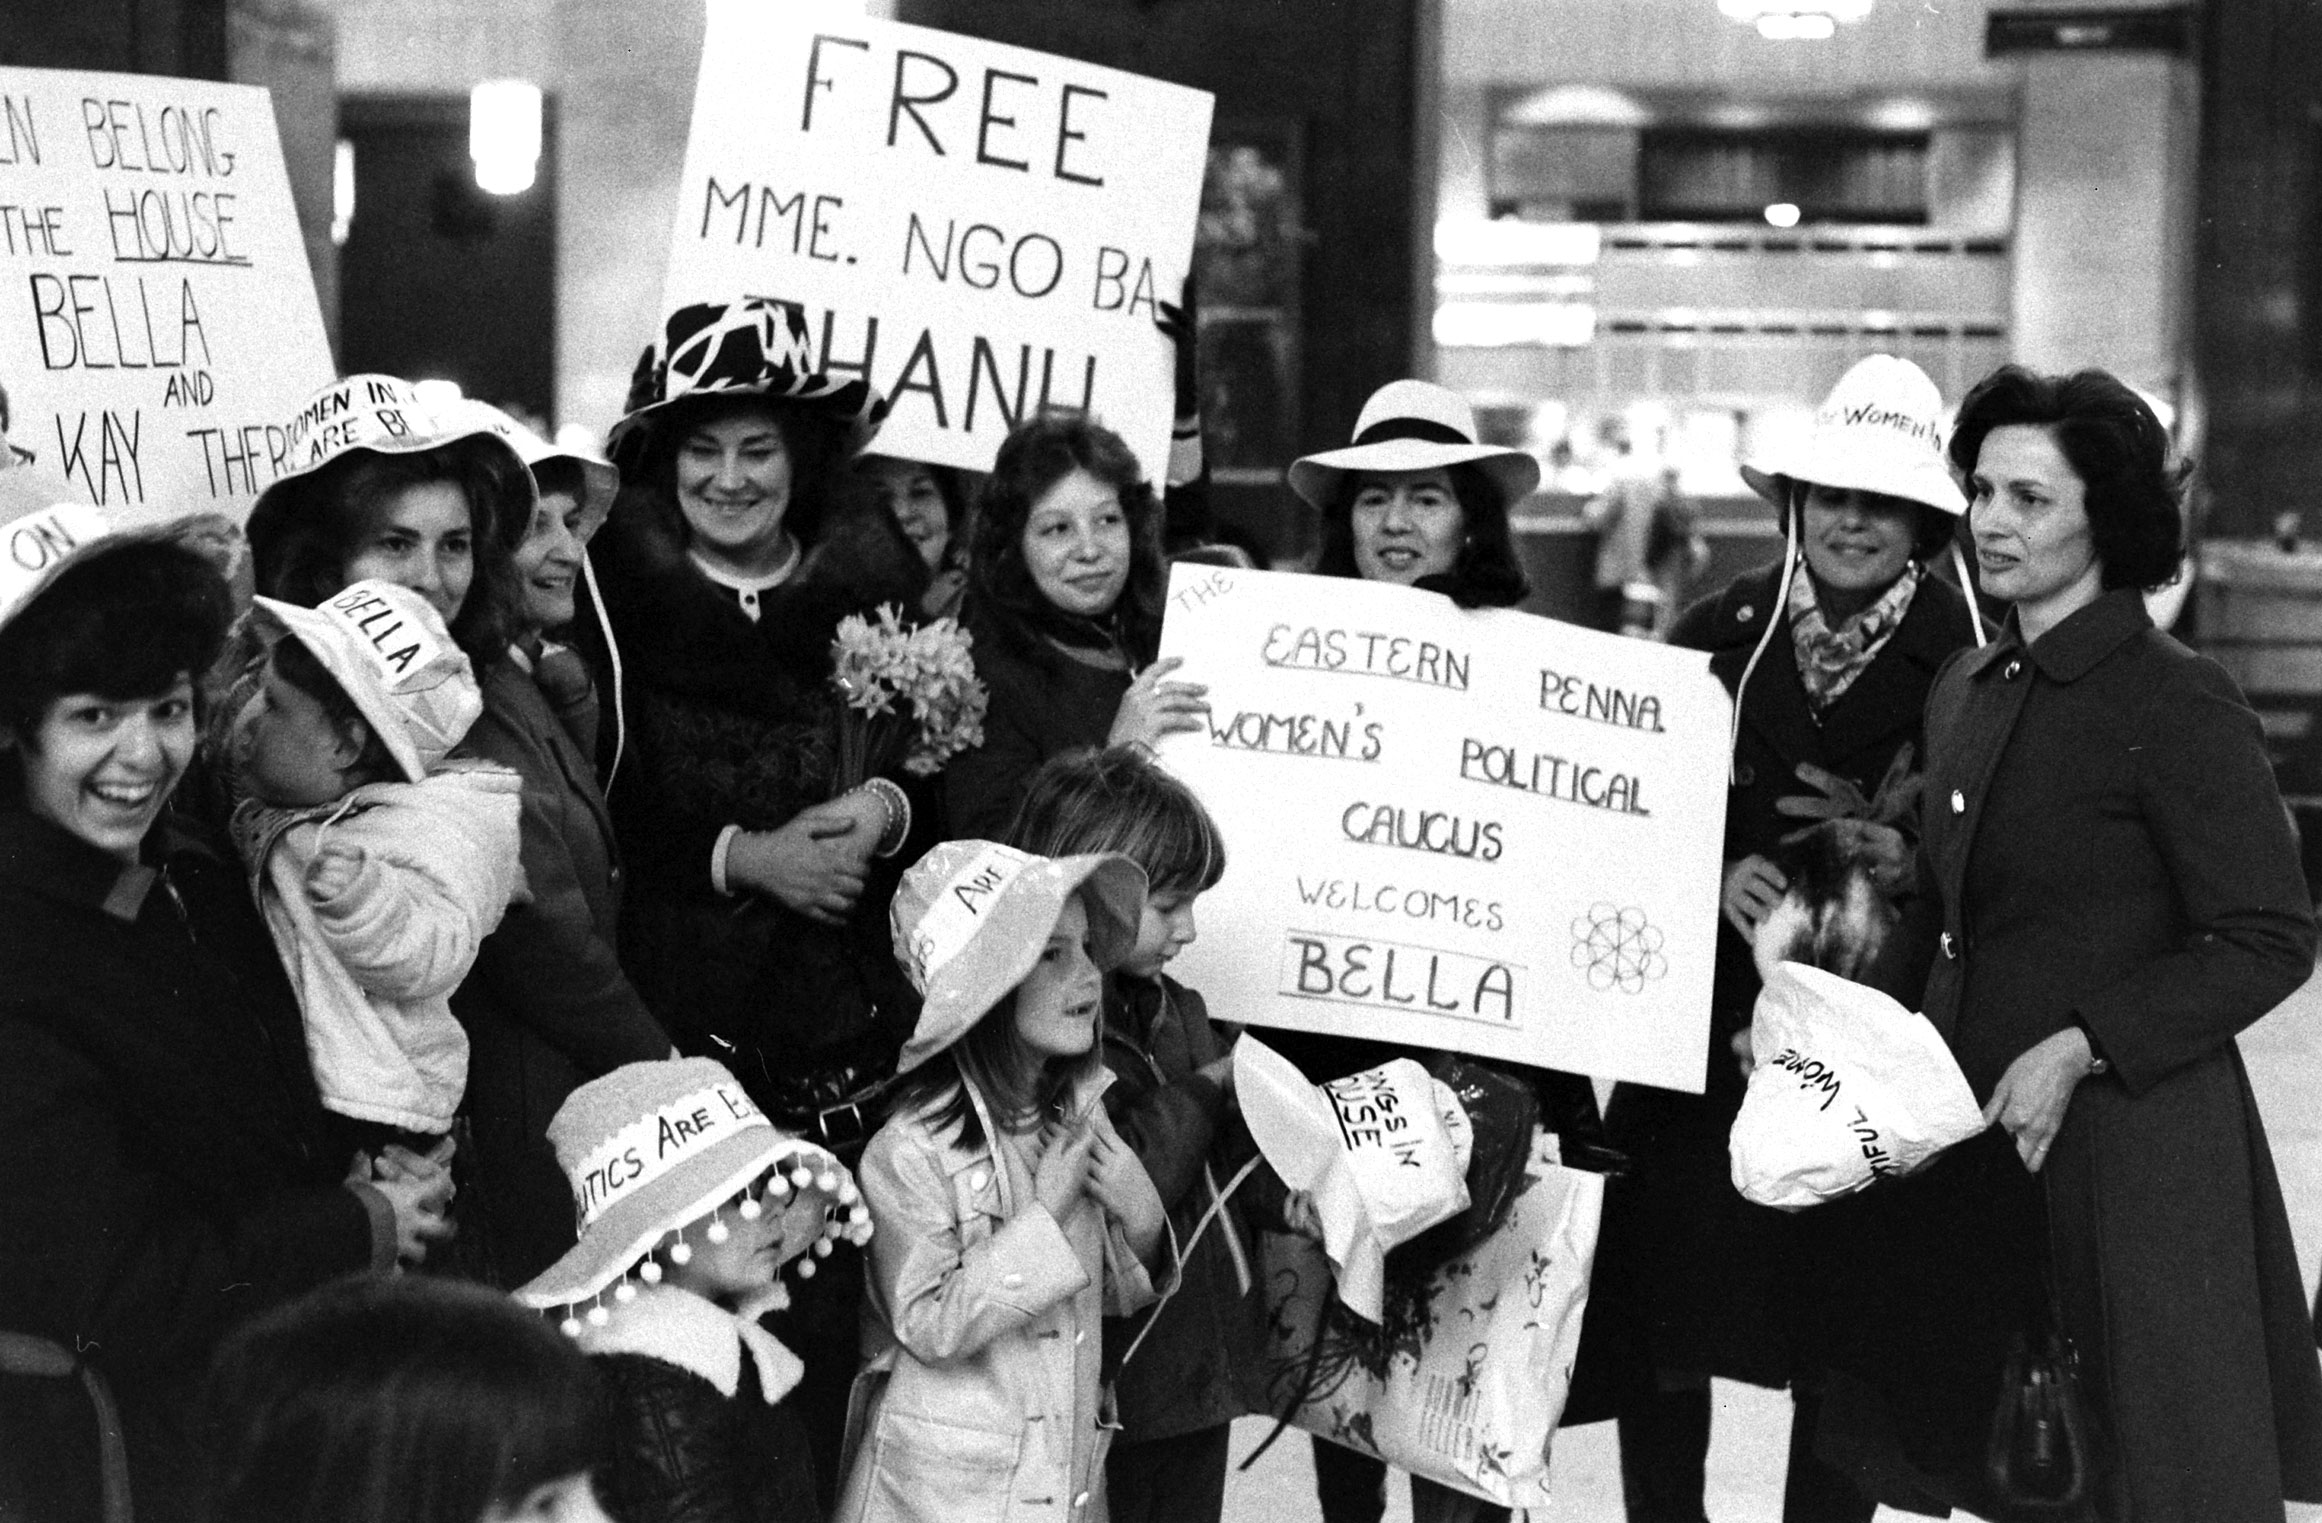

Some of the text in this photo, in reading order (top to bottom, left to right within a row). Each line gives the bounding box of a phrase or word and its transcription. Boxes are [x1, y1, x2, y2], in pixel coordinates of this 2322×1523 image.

[0, 95, 235, 177] N BELONG
[802, 34, 1108, 188] FREE
[0, 186, 248, 260] THE HOUSE
[700, 176, 858, 266] MME.
[903, 211, 1064, 299] NGO
[29, 272, 211, 370] BELLA
[164, 369, 214, 408] AND
[1844, 402, 1926, 439] WOMEN
[56, 409, 143, 506] KAY
[309, 416, 360, 465] ARE
[1170, 570, 1234, 613] THE
[333, 589, 421, 673] BELLA
[1261, 623, 1470, 689] EASTERN
[1207, 702, 1650, 816] WOMEN'S POLITICAL
[1341, 800, 1503, 861] CAUCUS
[1297, 875, 1504, 931] WELCOMES
[1290, 937, 1514, 1020] BELLA
[658, 1108, 716, 1160] ARE
